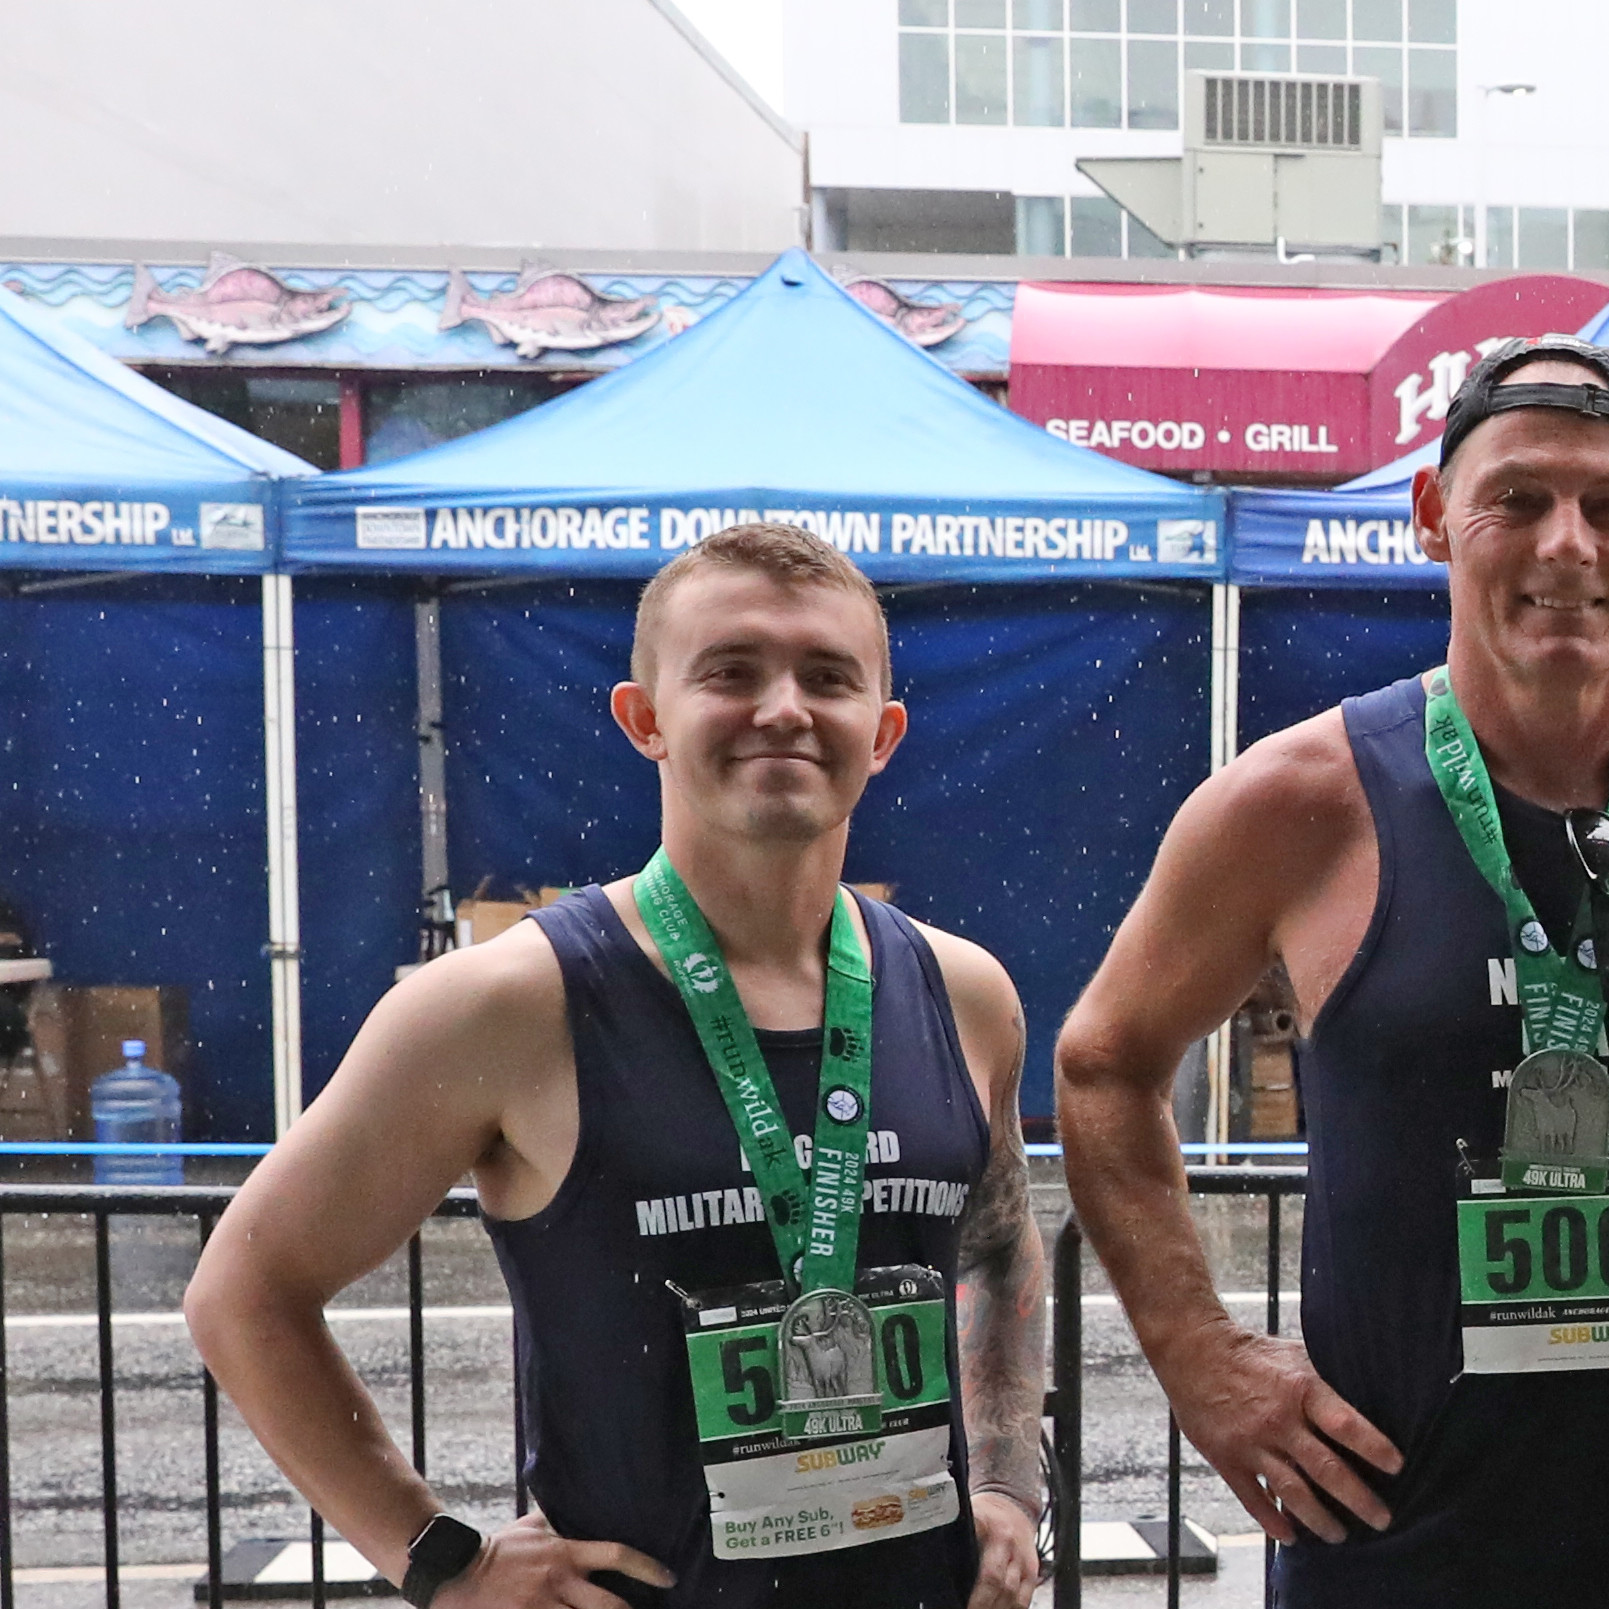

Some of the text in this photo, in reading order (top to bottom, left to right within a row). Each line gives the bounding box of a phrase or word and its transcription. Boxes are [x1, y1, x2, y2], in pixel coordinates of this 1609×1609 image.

[1046, 419, 1339, 453] SEAFOOD GRILL
[432, 507, 650, 550] ANCHORAGE
[660, 509, 880, 554] DOWOWN
[891, 513, 1129, 561] PARTNERSHIP
[1302, 518, 1446, 566] ANCHO
[1546, 991, 1584, 1051] FINIS
[1580, 1000, 1601, 1034] 2024
[709, 1014, 785, 1169] #runwildak
[843, 1151, 860, 1214] 2024 49K
[1523, 1169, 1586, 1190] 49K ULTRA
[635, 1178, 970, 1236] MILITAR PETITIONS
[810, 1147, 843, 1258] FINISHER
[1489, 1306, 1556, 1322] #runwildak
[803, 1415, 827, 1436] 49K
[829, 1414, 863, 1434] ULTRA
[732, 1436, 801, 1455] #runwild
[795, 1441, 886, 1474] SUBWAY
[725, 1507, 834, 1536] Buy Any Sub,
[726, 1536, 758, 1550] Get
[761, 1536, 771, 1546] a
[775, 1529, 817, 1544] FREE
